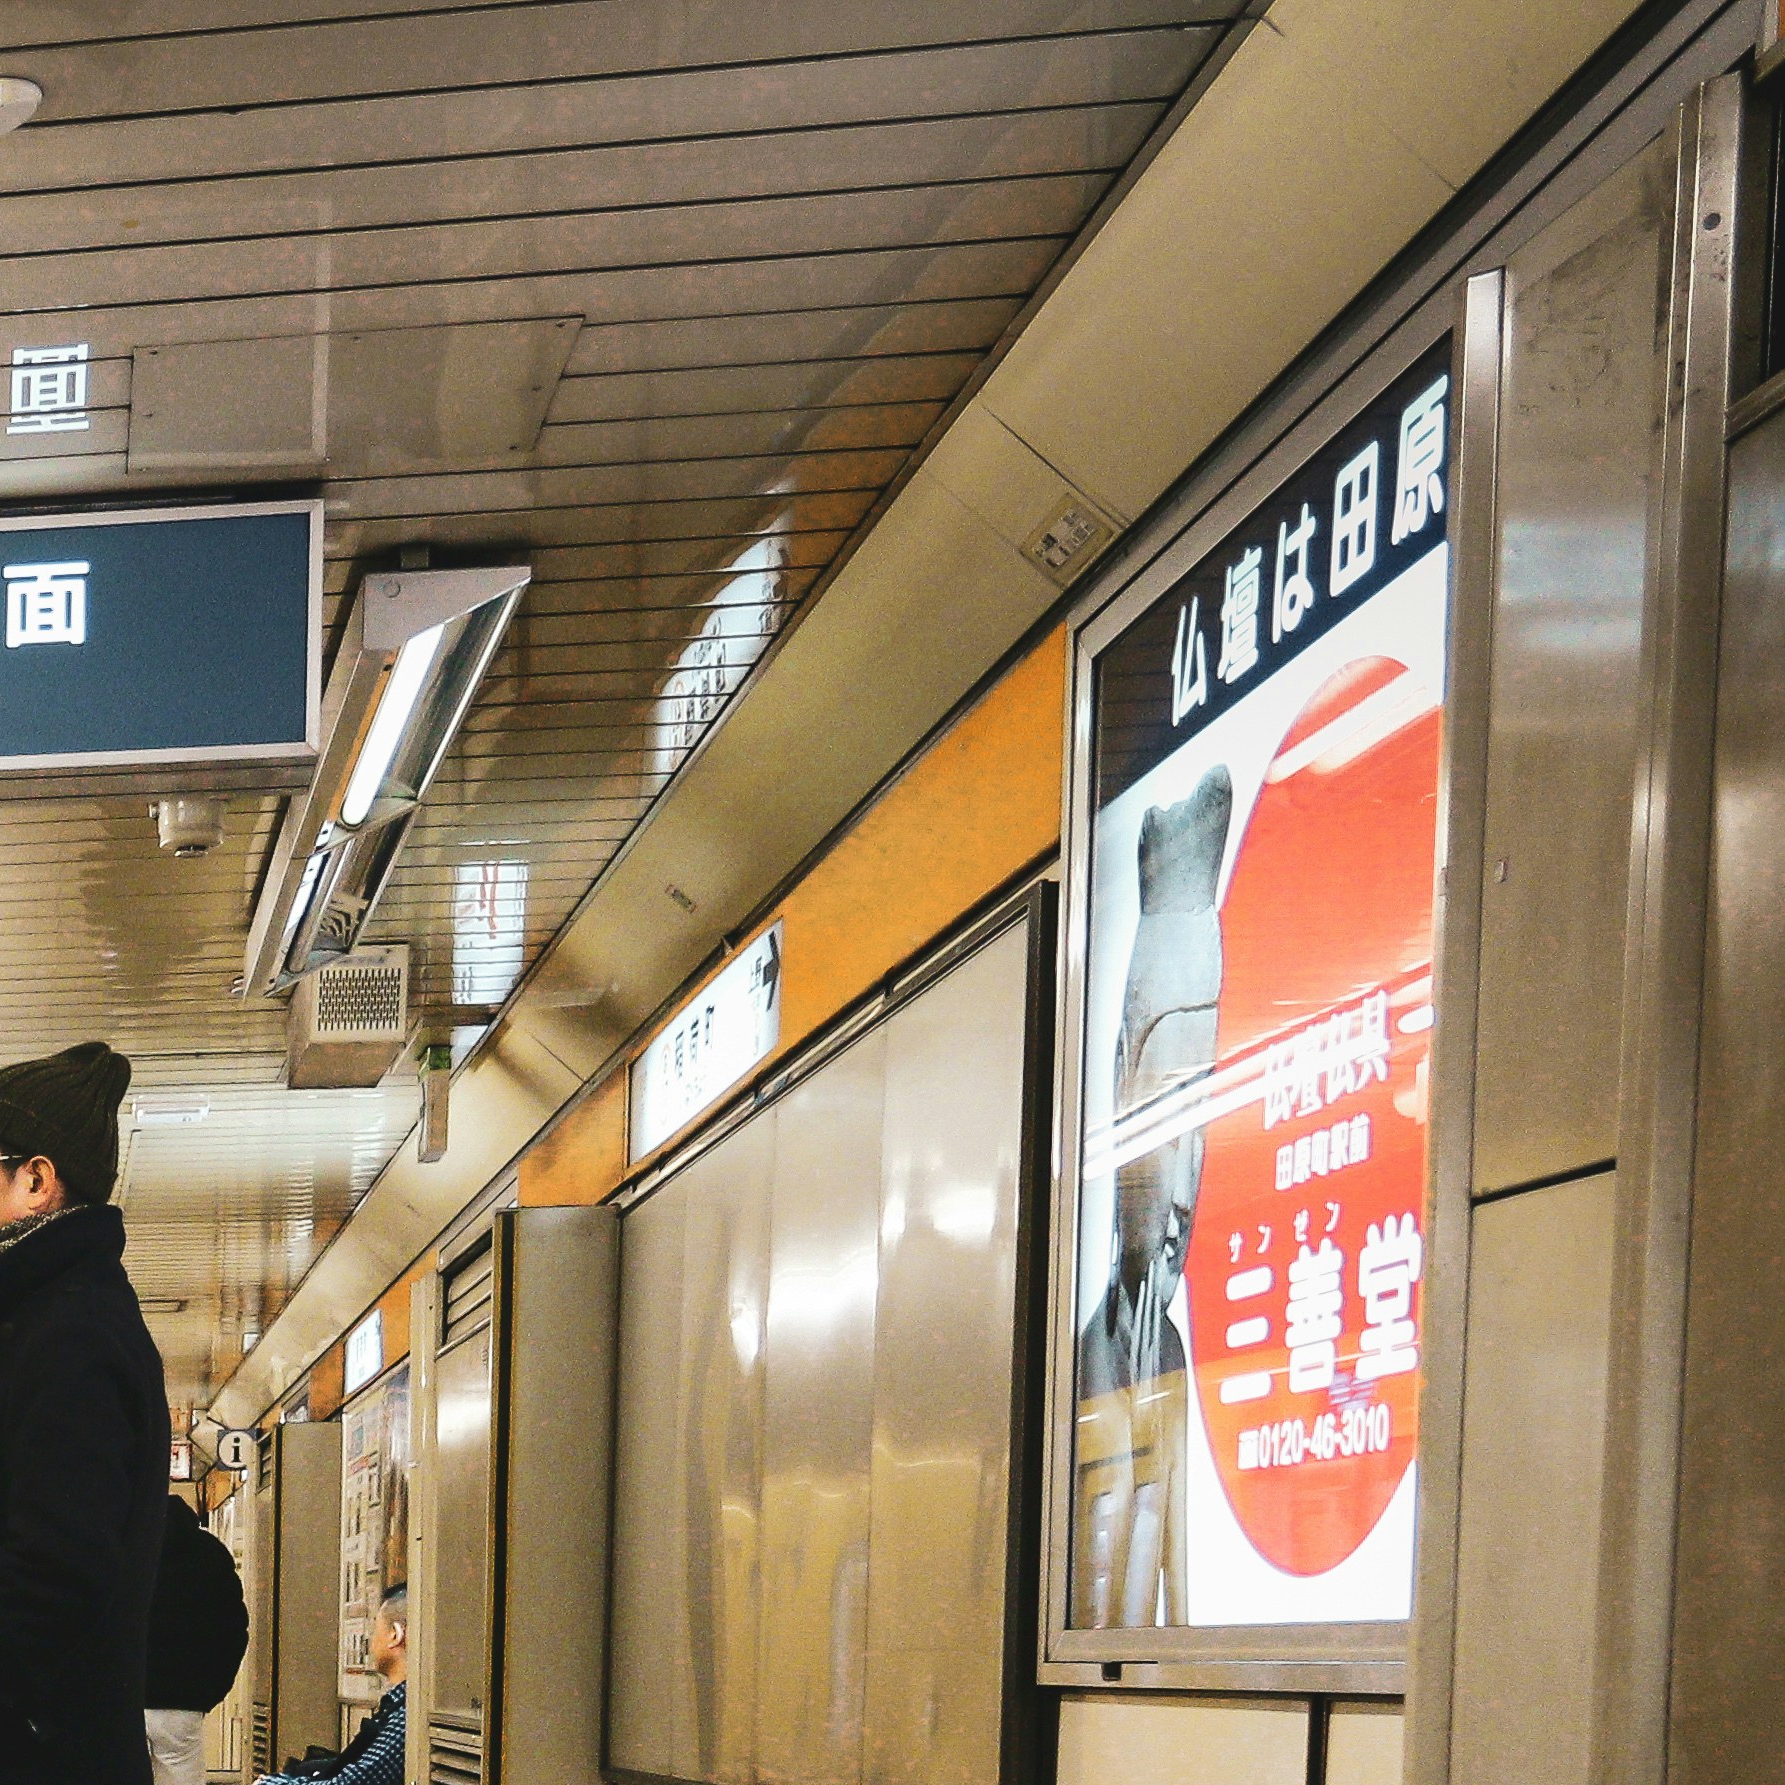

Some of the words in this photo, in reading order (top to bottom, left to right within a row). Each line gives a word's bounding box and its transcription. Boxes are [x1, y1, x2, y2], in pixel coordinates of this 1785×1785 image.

[1171, 374, 1448, 728] 仏壇は田原
[1218, 1211, 1425, 1405] 三善堂
[1258, 1403, 1391, 1470] 0120-46-3010
